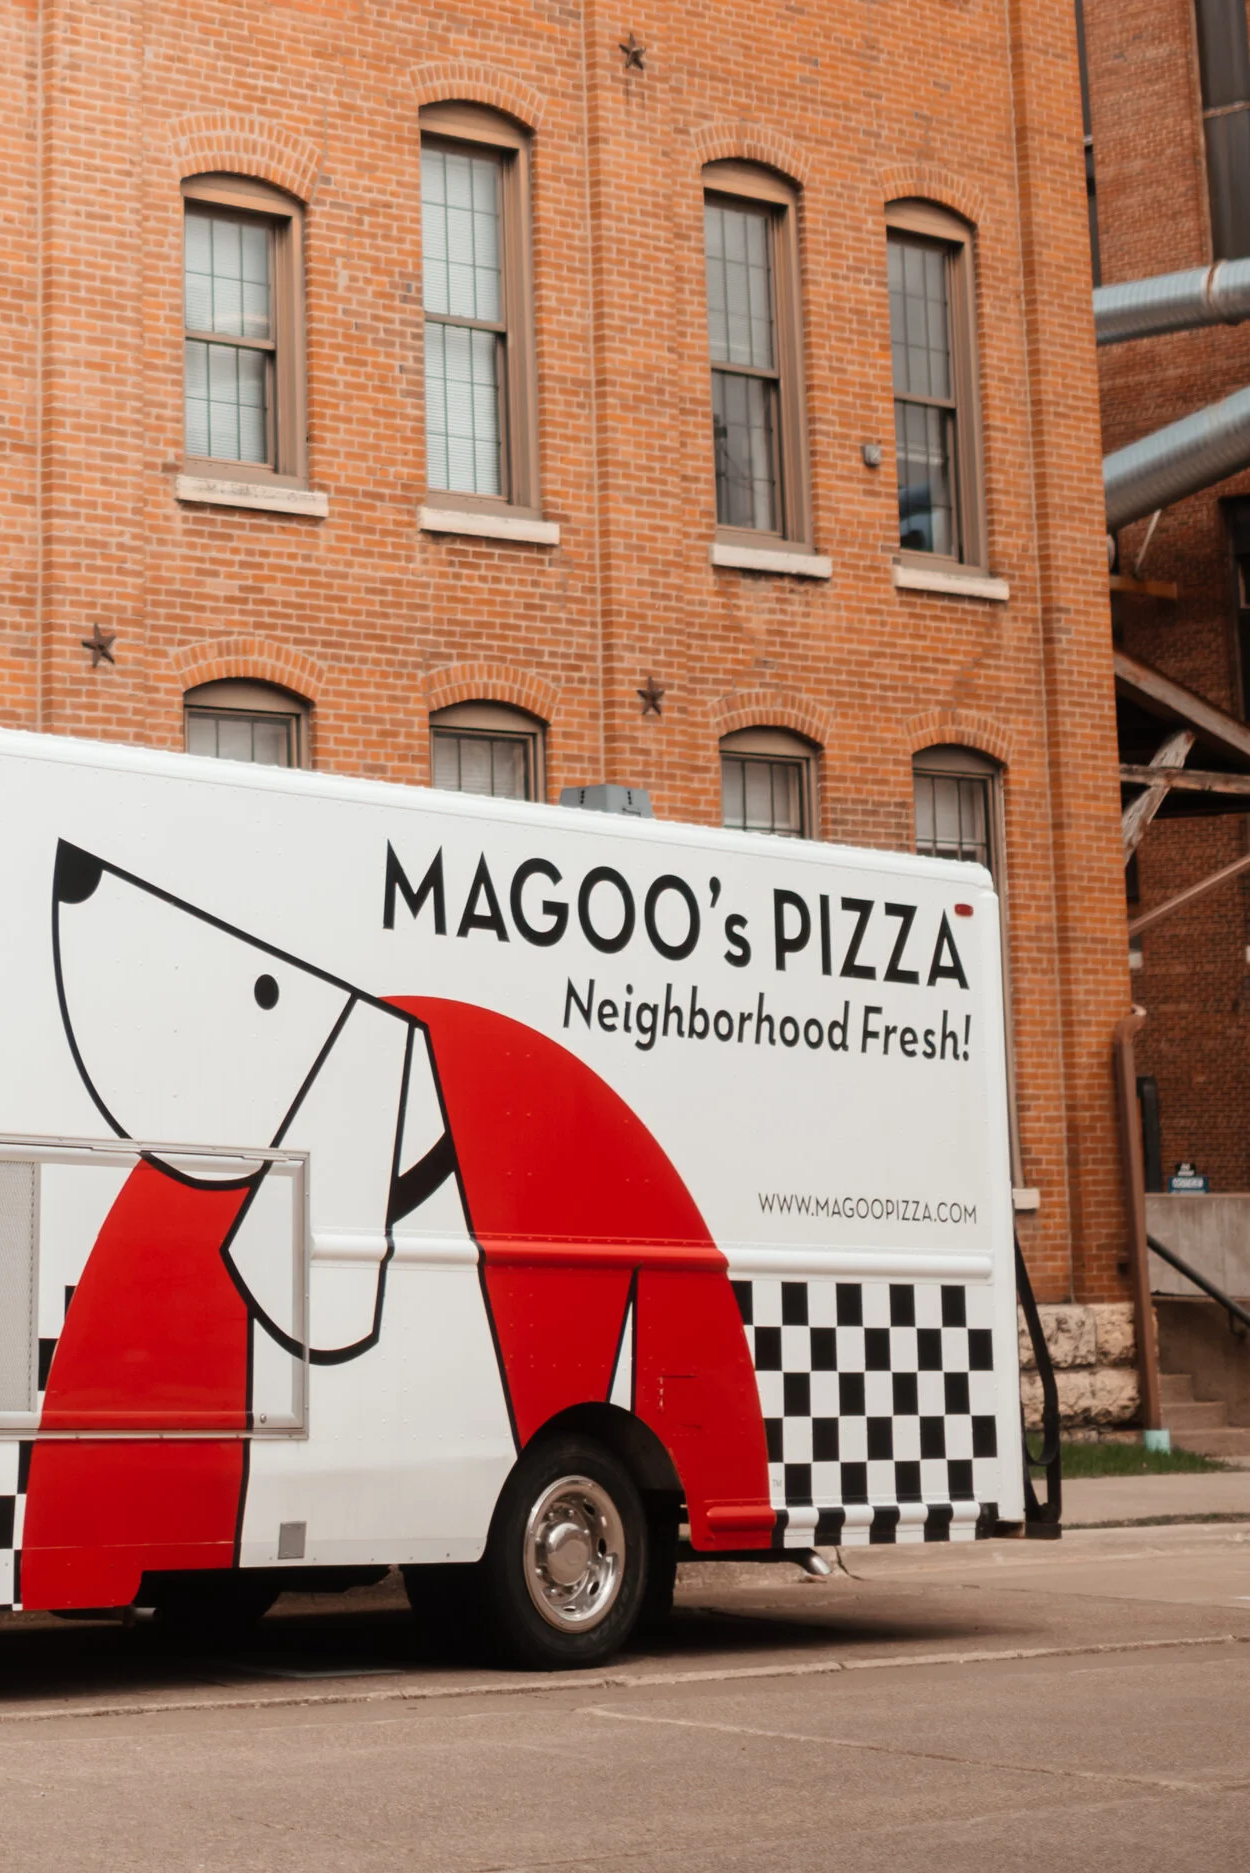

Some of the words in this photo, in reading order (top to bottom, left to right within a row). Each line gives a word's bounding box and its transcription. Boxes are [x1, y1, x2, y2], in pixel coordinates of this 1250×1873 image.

[382, 838, 751, 969] MAGOO's
[772, 887, 971, 991] PIZZA
[562, 976, 850, 1052] Neighborhood
[860, 1004, 972, 1063] Fresh!
[757, 1192, 978, 1225] WWW.MAGOOPIZZA.COM
